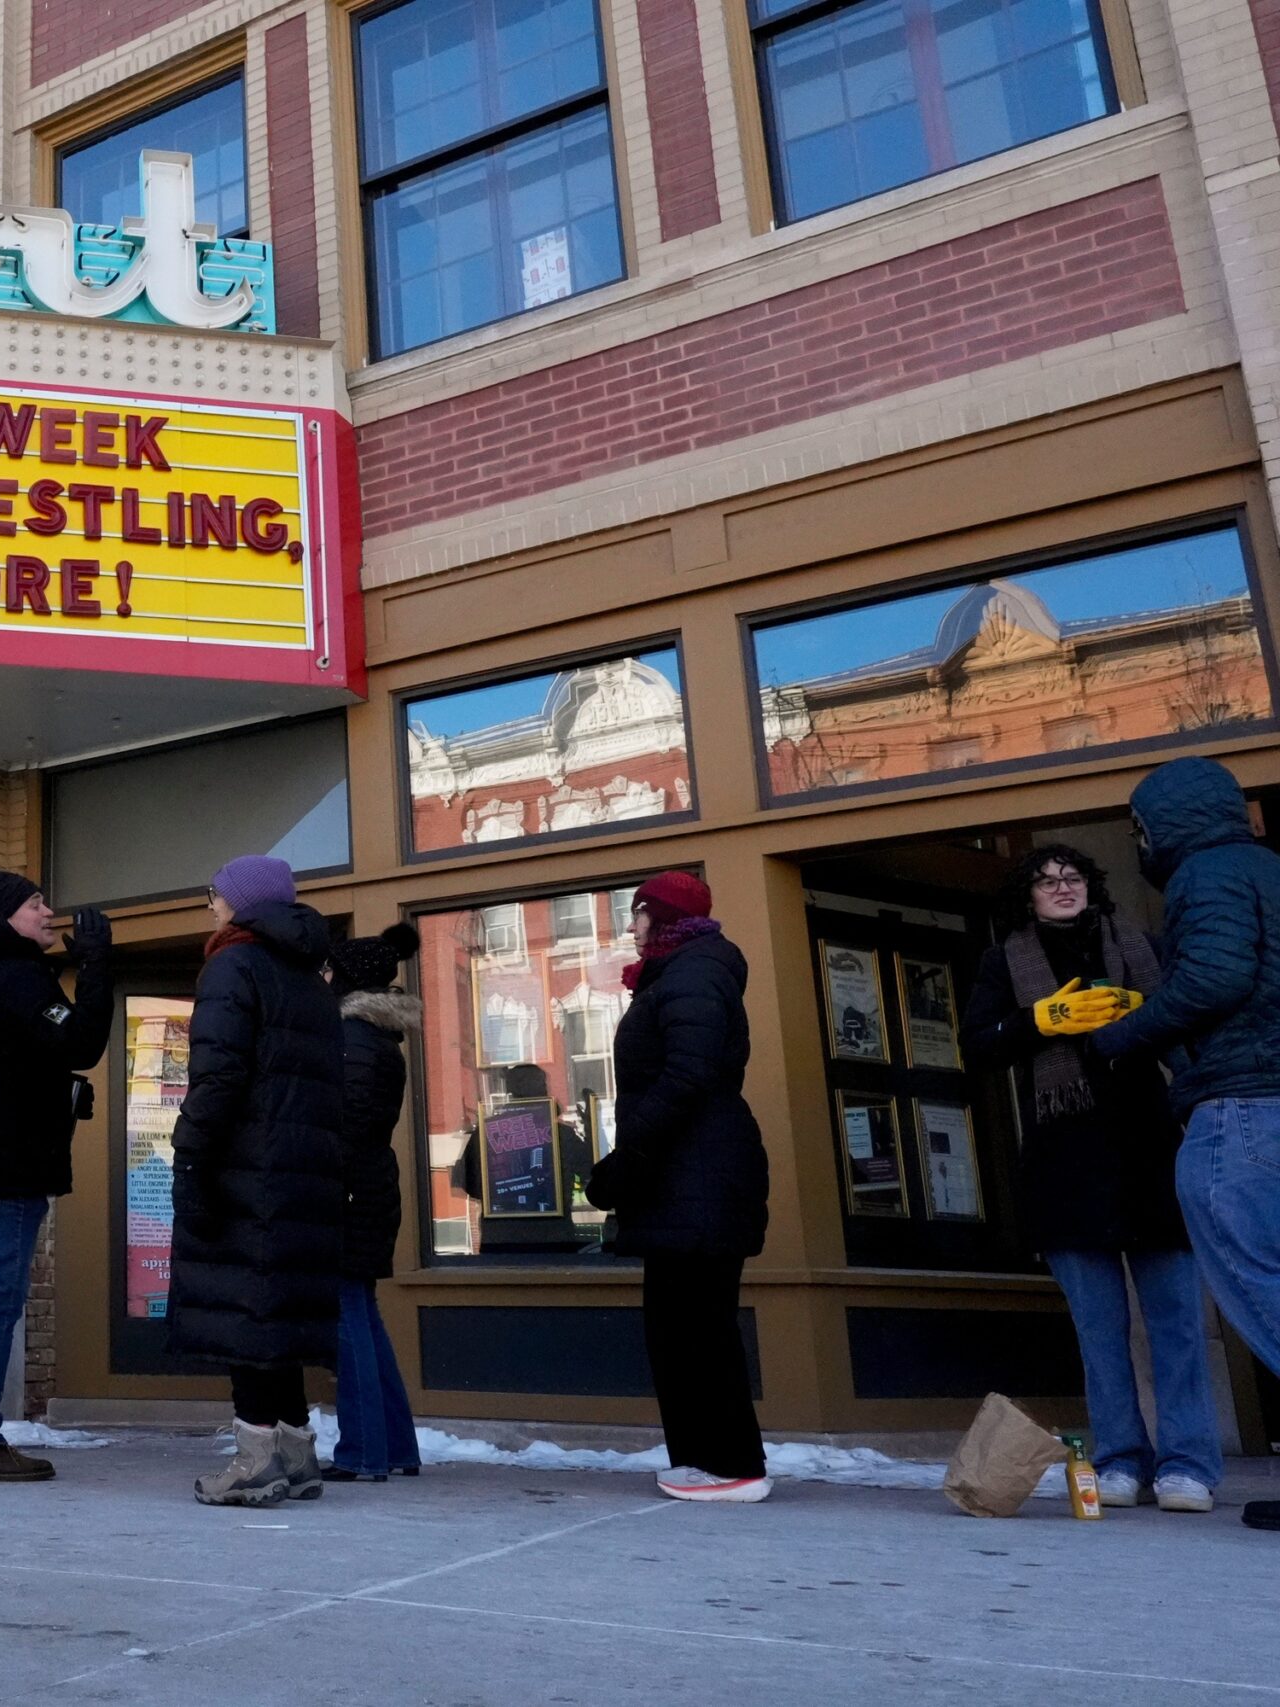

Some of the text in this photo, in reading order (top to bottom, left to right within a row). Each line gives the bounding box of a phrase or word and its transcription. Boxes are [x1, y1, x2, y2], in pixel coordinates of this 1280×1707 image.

[1047, 1002, 1063, 1026] IOWA
[486, 1113, 536, 1138] FREE
[487, 1126, 553, 1154] WEEK
[509, 1182, 534, 1193] VENUES
[141, 1256, 171, 1270] apri
